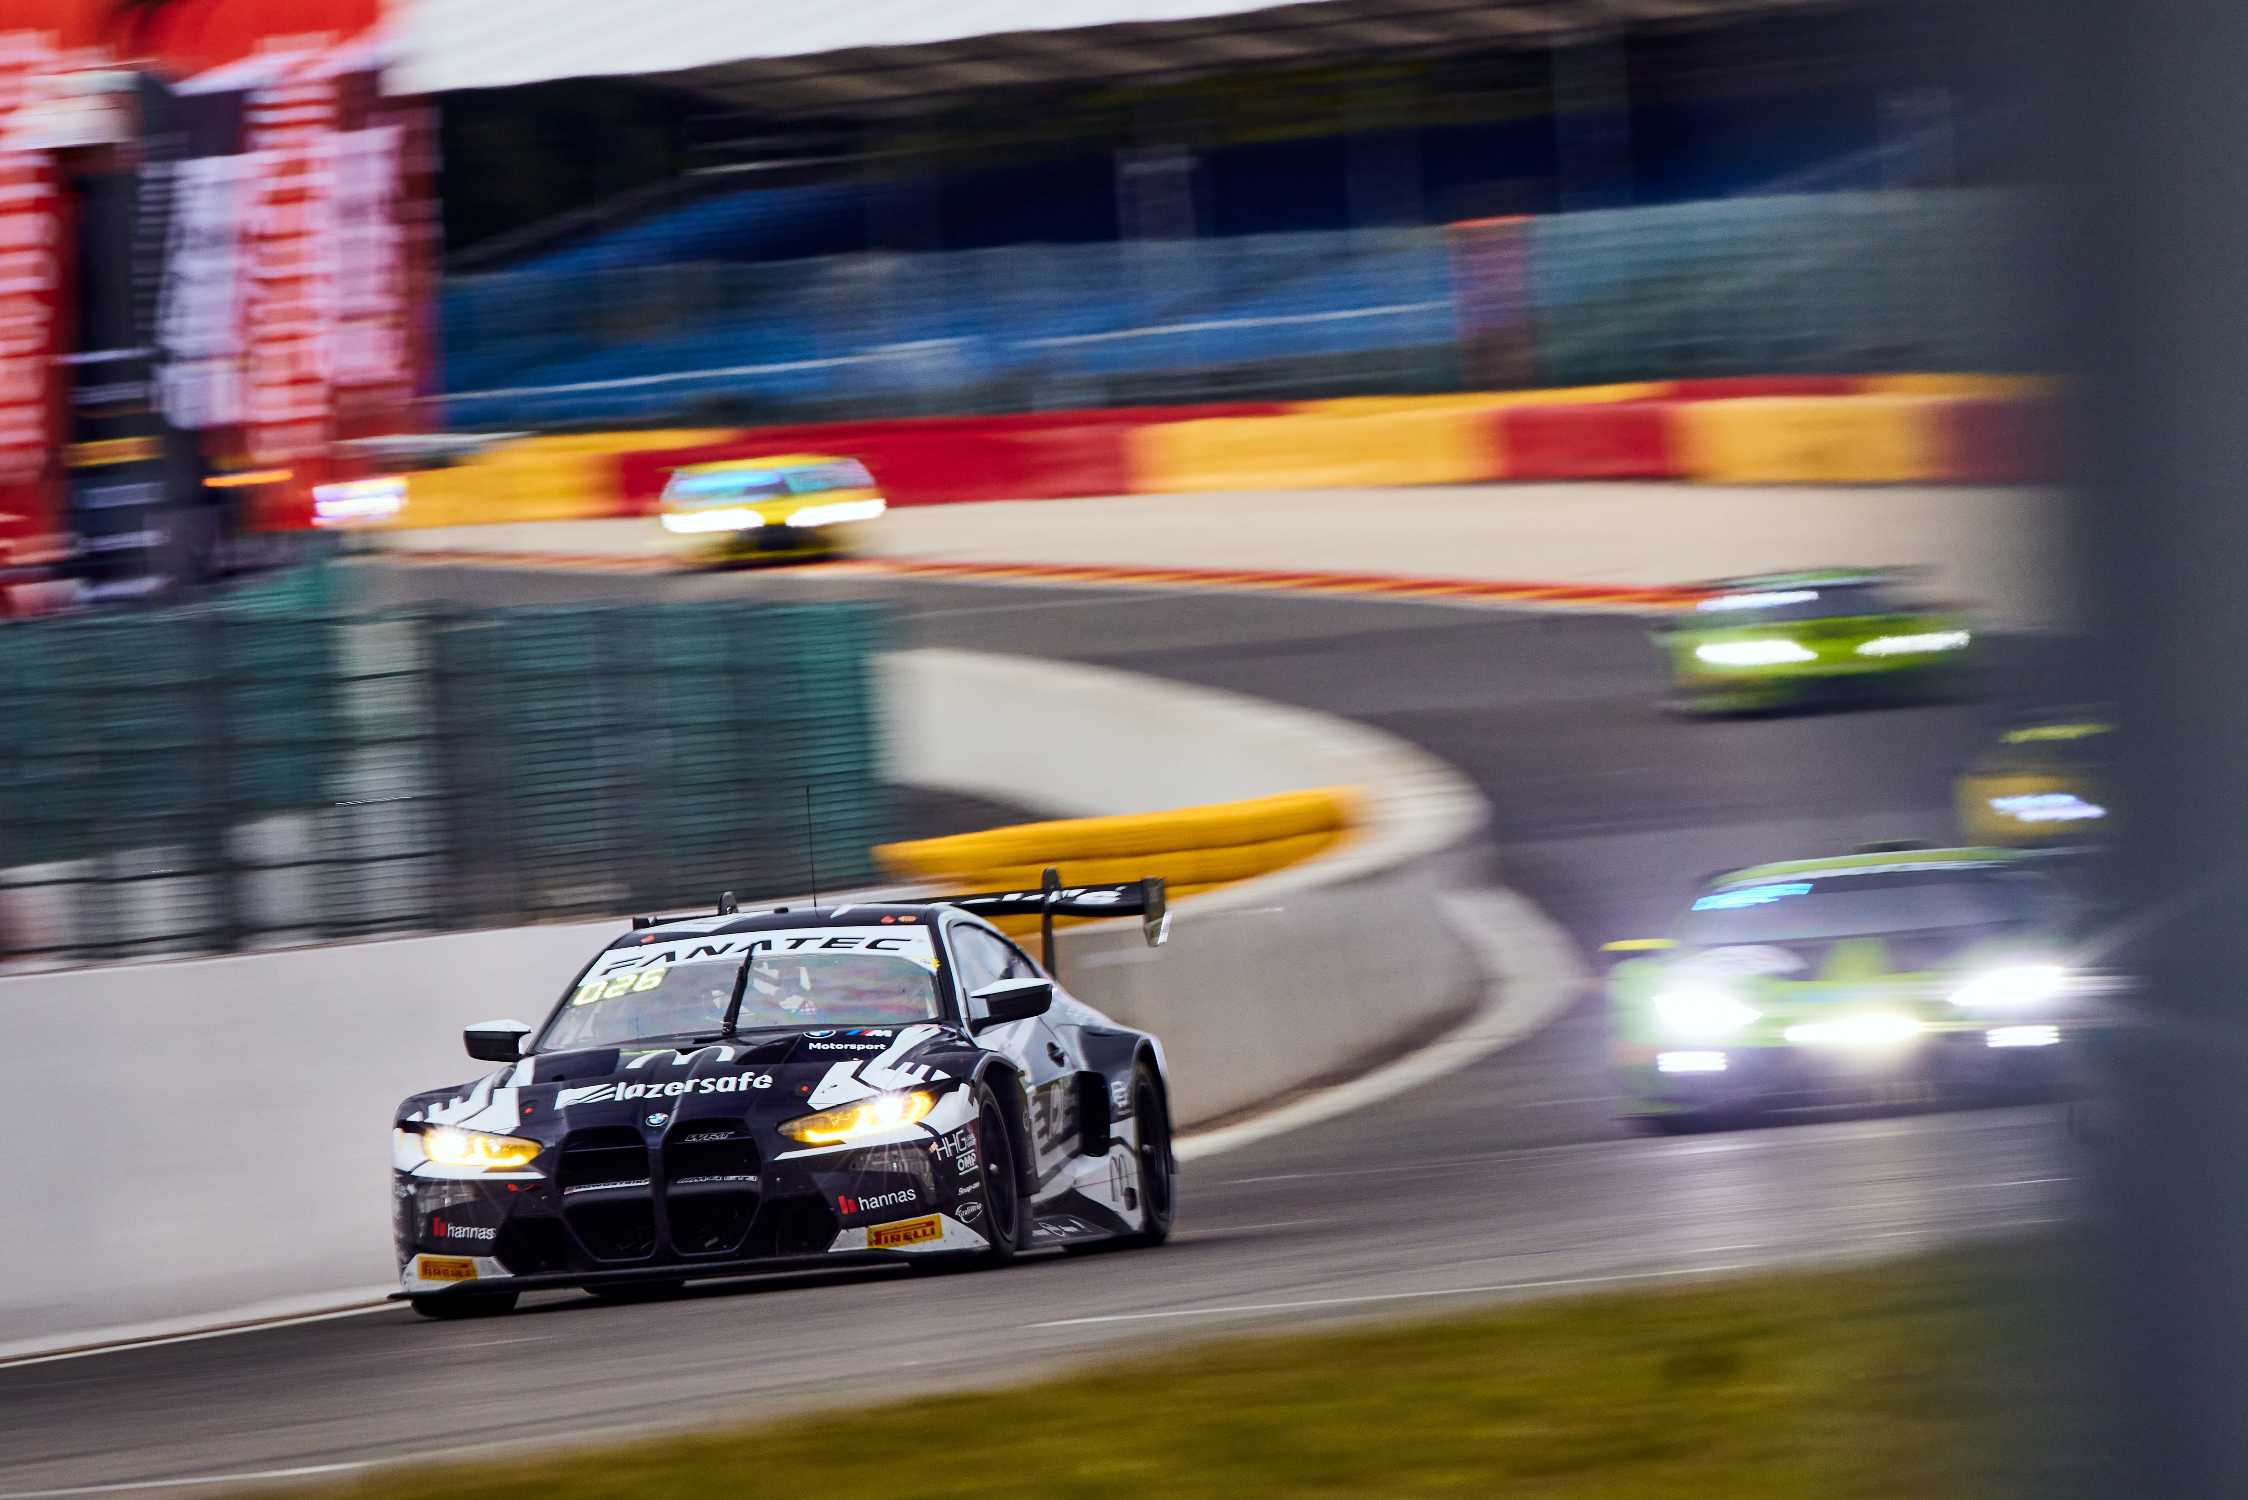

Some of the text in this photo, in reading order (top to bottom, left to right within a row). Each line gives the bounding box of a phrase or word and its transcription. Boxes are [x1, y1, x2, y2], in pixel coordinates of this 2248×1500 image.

[600, 937, 911, 977] FANATEC
[808, 1042, 887, 1051] Motorsport
[614, 1071, 774, 1101] lazersafe
[957, 1153, 977, 1172] OMP
[858, 1188, 917, 1212] hannas
[447, 1222, 497, 1240] hannas
[873, 1219, 936, 1247] PIRELLI
